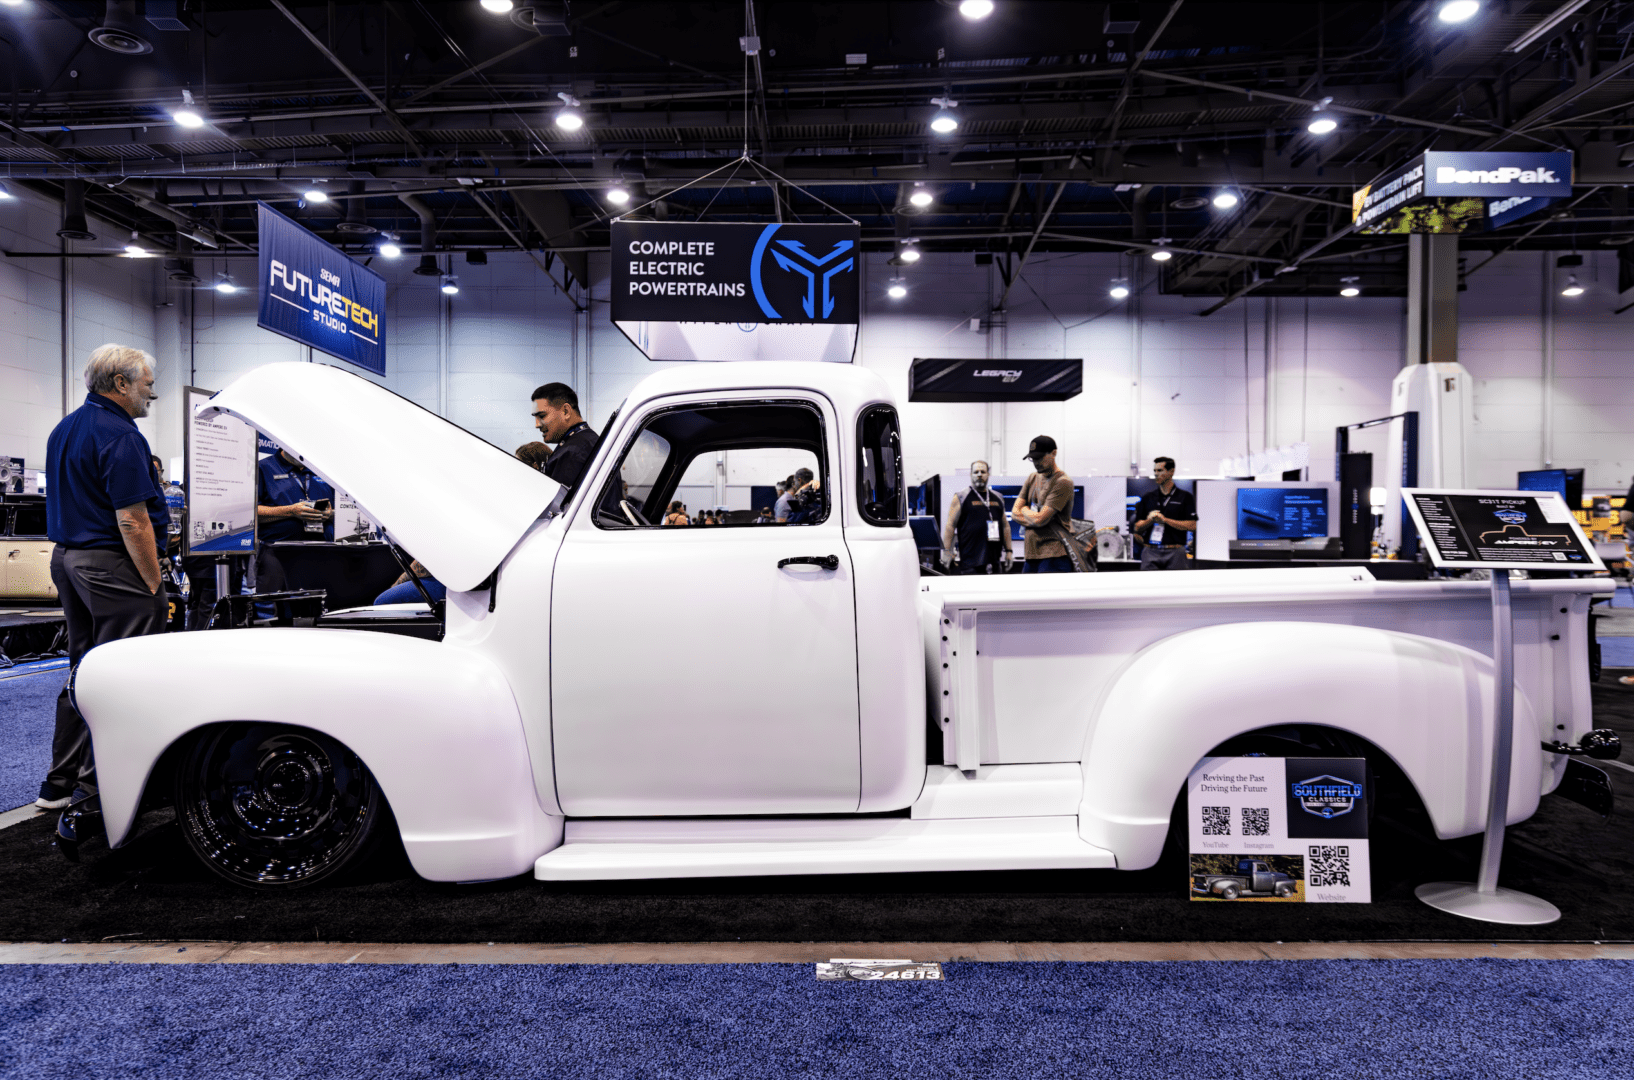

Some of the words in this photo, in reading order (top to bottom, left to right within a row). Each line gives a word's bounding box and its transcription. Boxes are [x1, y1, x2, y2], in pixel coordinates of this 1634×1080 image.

[629, 241, 715, 255] COMPLETE
[629, 261, 704, 275] ELECTRIC
[320, 268, 340, 287] SEMA
[629, 282, 745, 297] POWERTRAINS
[270, 259, 378, 338] FUTURETECH
[313, 309, 346, 334] STUDIO
[973, 369, 1022, 377] LEGACY
[1203, 773, 1235, 783] Reviving
[1236, 774, 1248, 782] the
[1249, 774, 1265, 782] Past
[1200, 784, 1229, 794] Driving
[1230, 784, 1242, 792] the
[1243, 784, 1268, 793] Future
[1294, 785, 1361, 797] SOUTHFIELD
[1244, 842, 1275, 850] Instagram
[1317, 893, 1346, 901] Website
[869, 970, 941, 980] 24613
